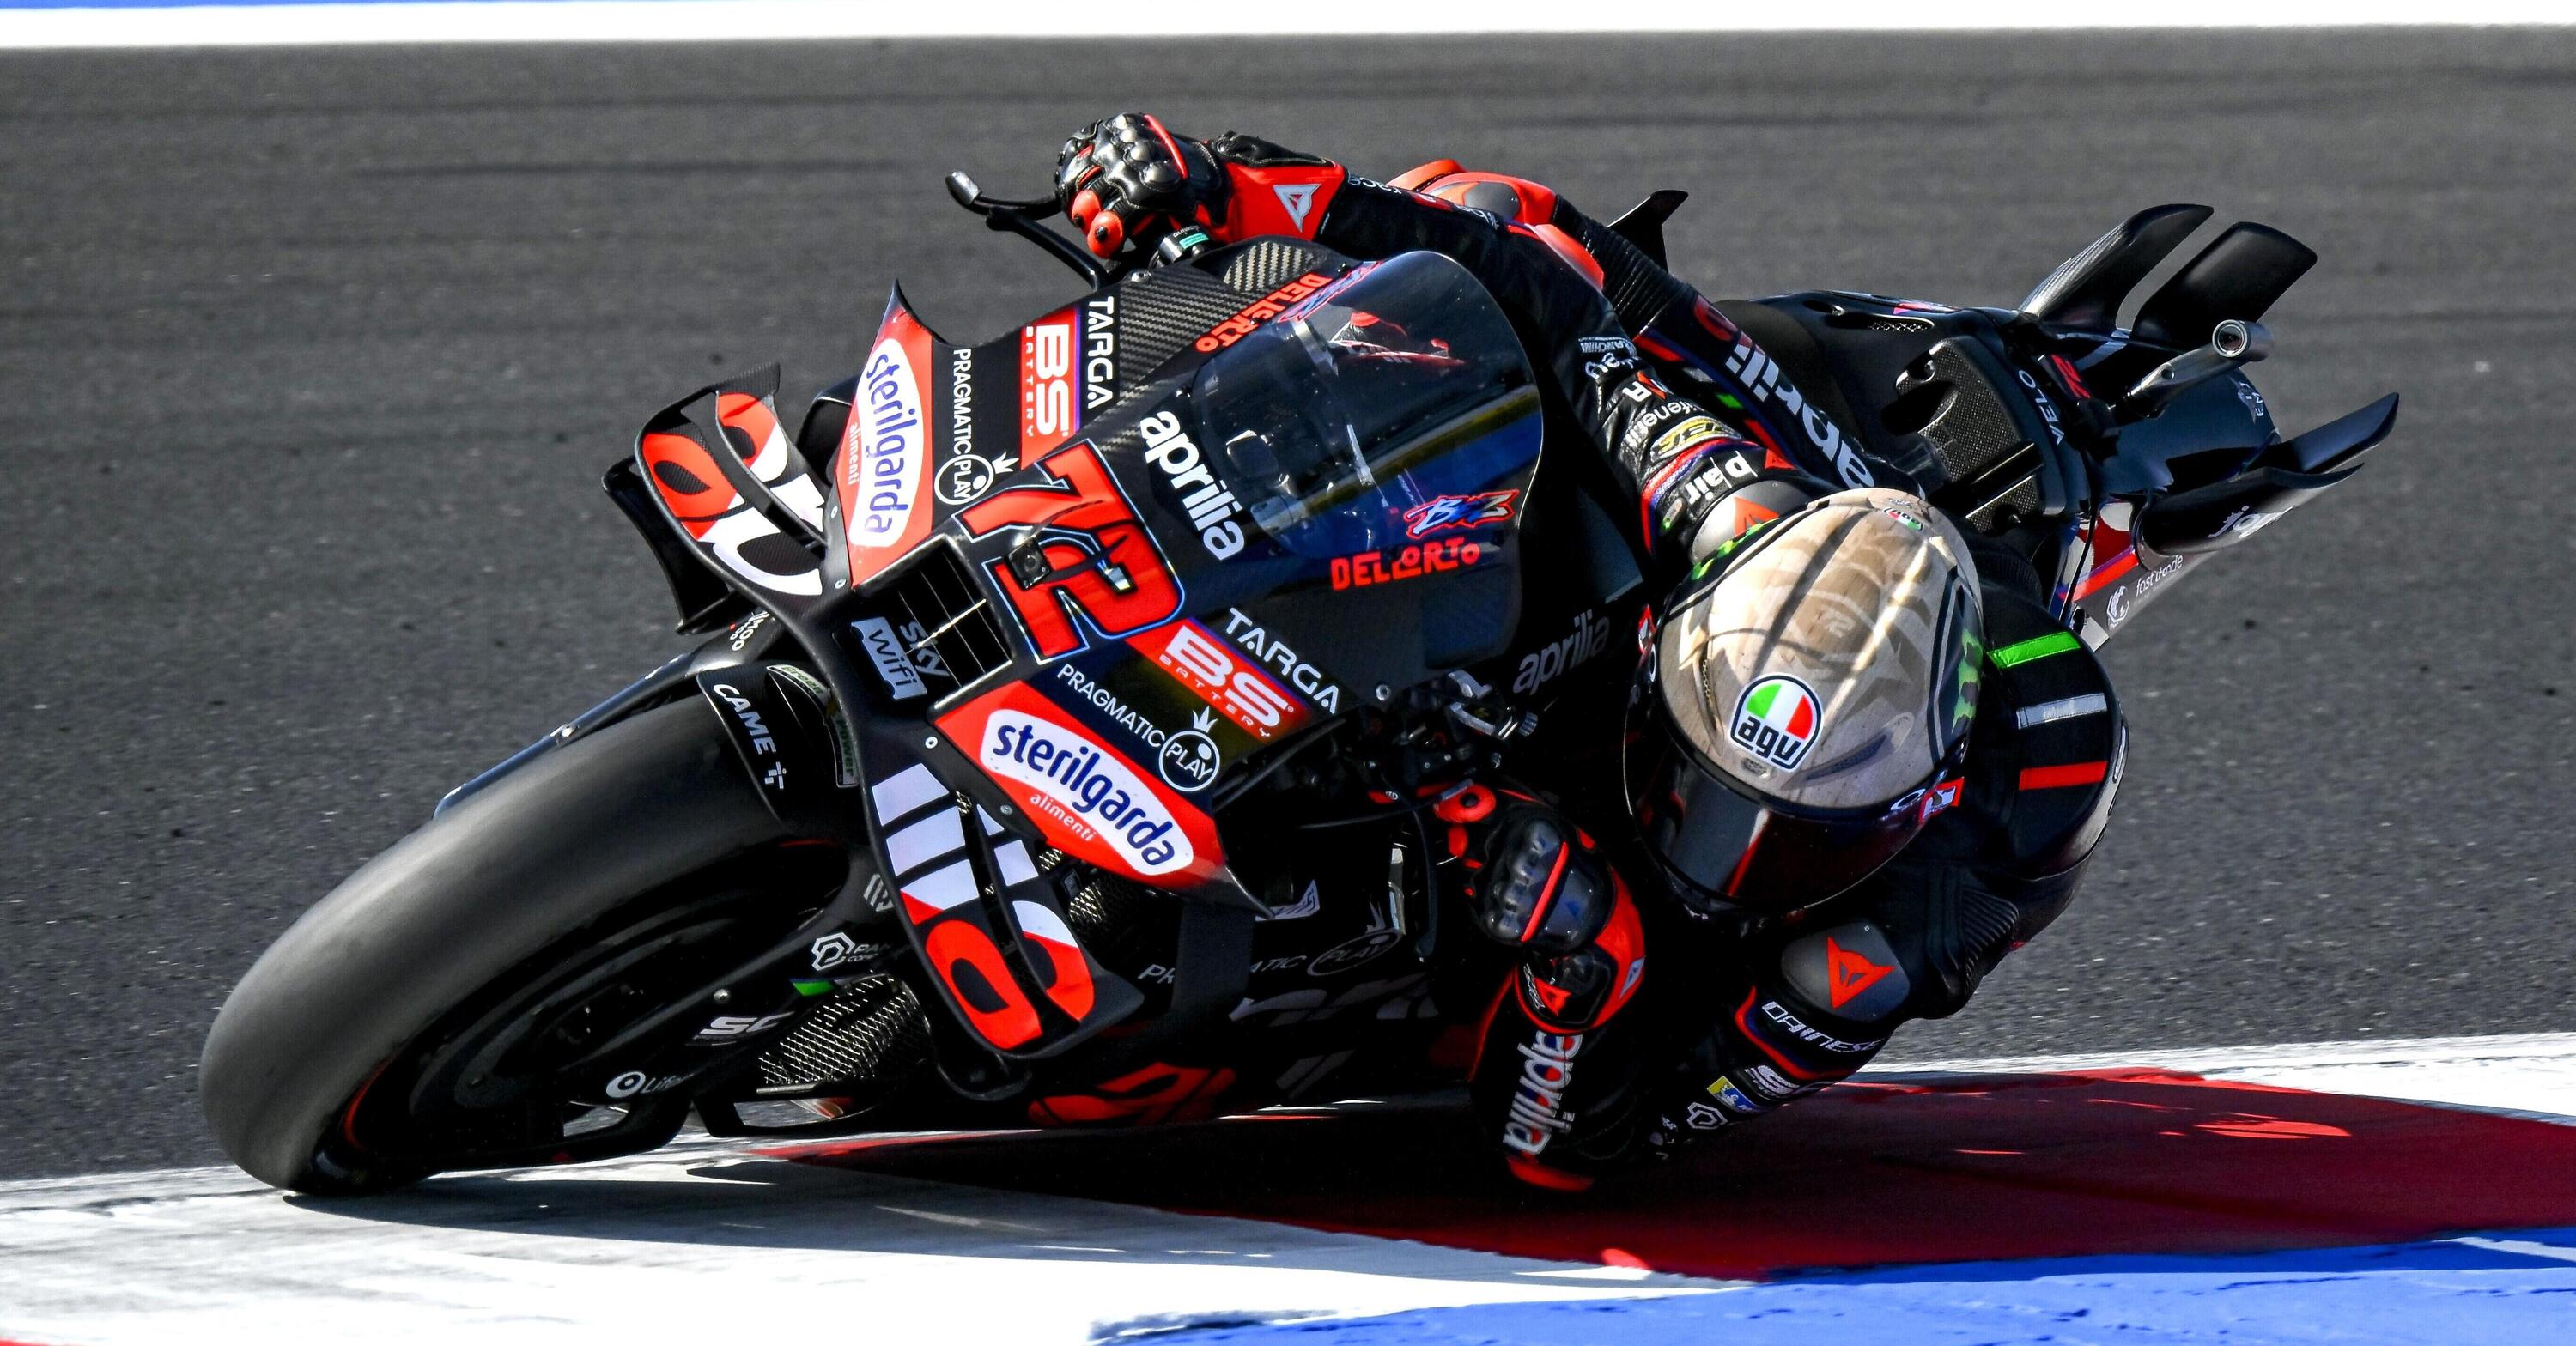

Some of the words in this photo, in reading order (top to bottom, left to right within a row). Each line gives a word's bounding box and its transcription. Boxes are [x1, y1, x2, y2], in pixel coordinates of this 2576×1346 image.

[954, 349, 972, 454] PRAGMATIC
[1024, 325, 1034, 438] BATTERY
[1036, 324, 1070, 436] BS
[1087, 296, 1114, 409] TARGA
[848, 421, 860, 486] alimenti
[865, 354, 917, 534] sterilgarda
[2020, 370, 2064, 445] VELO
[954, 460, 973, 500] PLAY
[1140, 409, 1245, 561] aprilia
[951, 438, 1185, 665] 72
[867, 629, 917, 688] wifi
[1159, 653, 1271, 737] BATTERY
[1165, 625, 1288, 728] BS
[1224, 608, 1339, 715] TARGA
[1512, 609, 1611, 696] aprilia
[714, 683, 776, 755] CAME
[1057, 664, 1166, 748] PRAGMATIC
[1166, 742, 1214, 782] PLAY
[1738, 715, 1803, 765] agv
[993, 724, 1176, 866] sterilgarda
[1030, 792, 1097, 842] alimenti
[1503, 1031, 1583, 1155] aprilia
